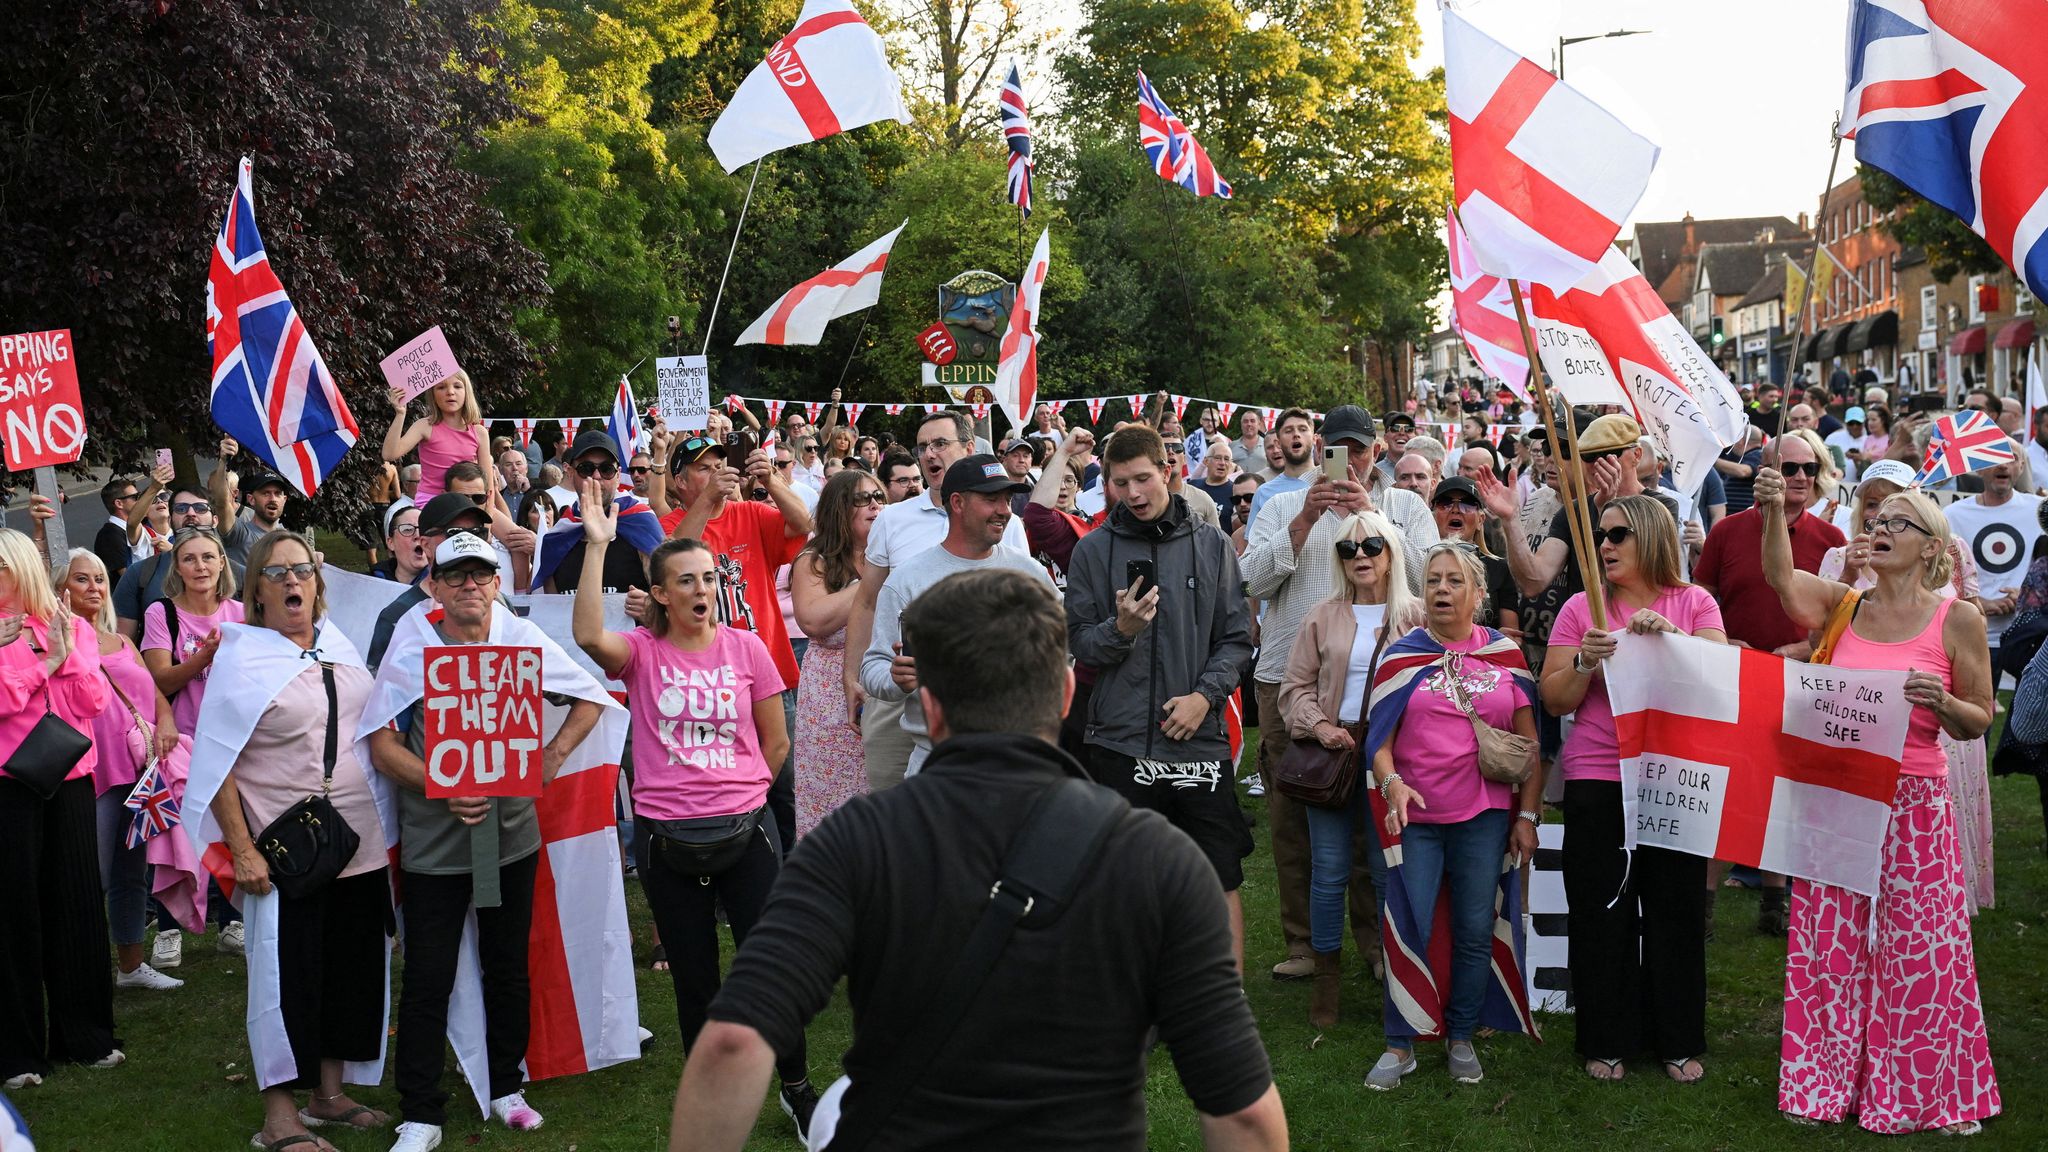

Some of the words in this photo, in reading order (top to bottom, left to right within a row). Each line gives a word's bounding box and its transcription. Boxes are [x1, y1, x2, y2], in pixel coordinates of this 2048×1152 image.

[0, 331, 68, 369] PPING
[1539, 328, 1569, 347] STOP
[397, 340, 432, 370] PROTECT
[412, 359, 425, 371] US
[677, 357, 685, 367] A
[1565, 358, 1605, 376] BOATS
[407, 371, 422, 387] AND
[424, 360, 440, 375] OUR
[413, 368, 444, 391] FUTURE
[658, 366, 706, 378] GOVERNMENT
[659, 379, 688, 388] FAILING
[691, 377, 701, 387] TO
[941, 362, 998, 382] EPPIN
[0, 368, 53, 402] SAYS
[660, 388, 690, 399] PROTECT
[693, 387, 703, 397] US
[662, 398, 670, 408] IS
[674, 398, 684, 407] AN
[688, 397, 702, 406] ACT
[1636, 374, 1703, 422] PROTEC
[662, 408, 672, 418] OF
[674, 406, 707, 417] TREASON
[6, 403, 83, 464] NO
[1524, 607, 1554, 641] 23
[428, 650, 541, 697] CLEAR
[660, 665, 737, 689] LEAVE
[658, 684, 738, 719] OUR
[1801, 676, 1846, 693] KEEP
[1856, 686, 1883, 704] OUR
[427, 692, 539, 735] THEM
[658, 719, 737, 748] KIDS
[1824, 721, 1861, 742] SAFE
[429, 738, 539, 788] OUT
[667, 747, 737, 768] ALONE
[1639, 761, 1667, 780] EP
[1678, 768, 1710, 792] OUR
[1638, 788, 1709, 814] HILDREN
[1637, 814, 1680, 836] SAFE
